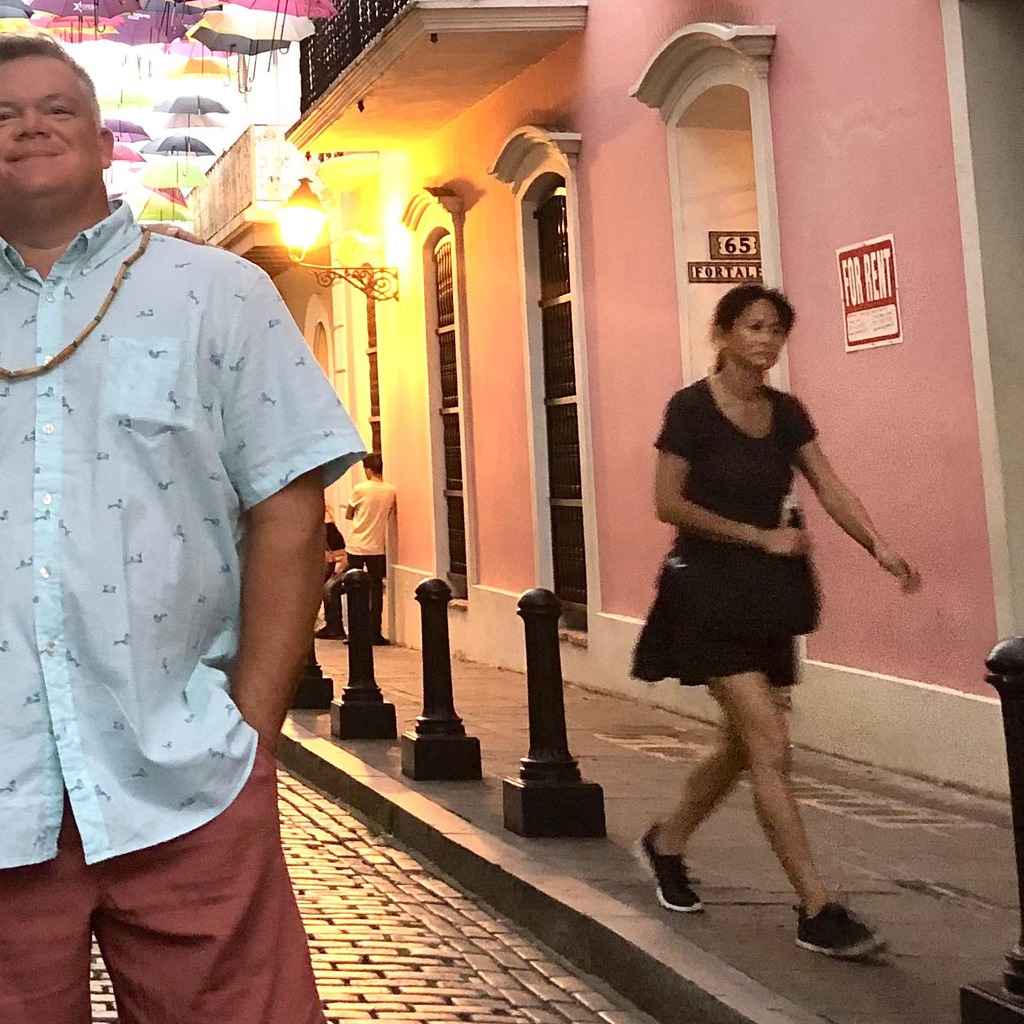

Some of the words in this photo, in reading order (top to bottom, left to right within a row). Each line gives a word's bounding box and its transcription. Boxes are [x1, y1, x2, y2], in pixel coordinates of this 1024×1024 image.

[724, 237, 751, 254] 65
[841, 256, 865, 307] FOR
[863, 248, 892, 303] RENT
